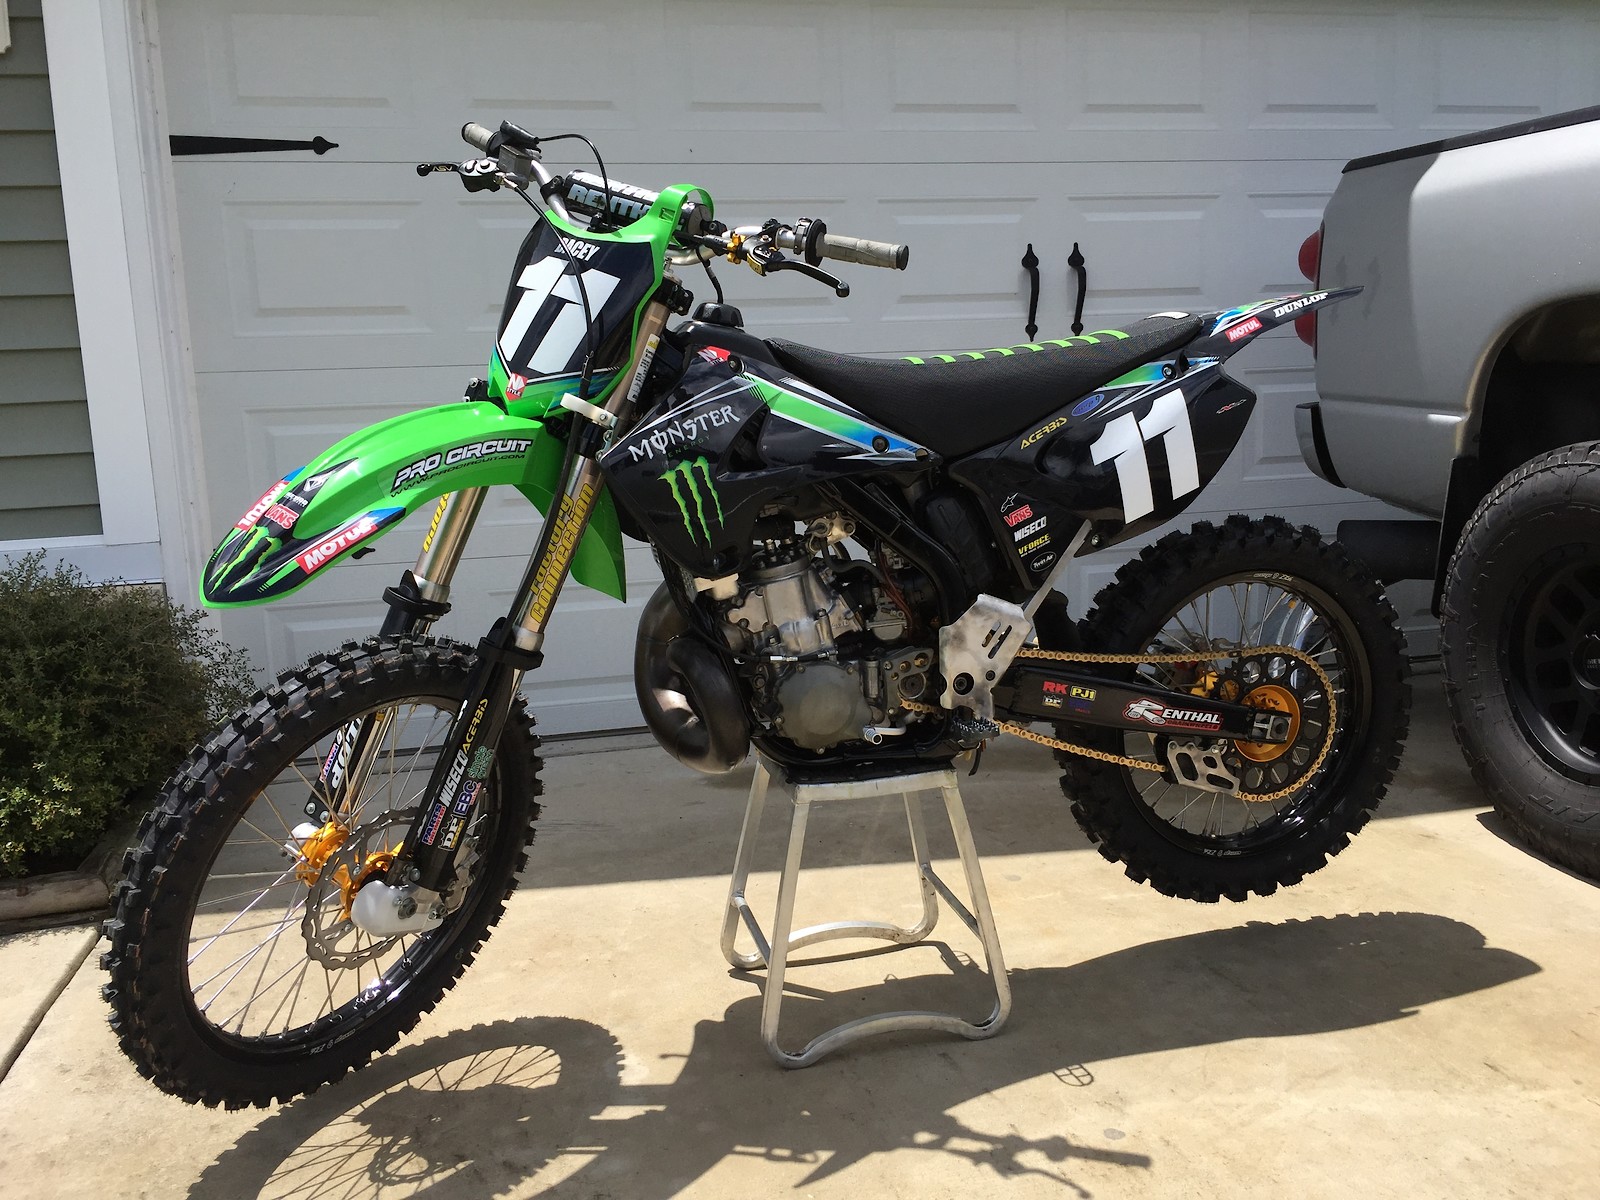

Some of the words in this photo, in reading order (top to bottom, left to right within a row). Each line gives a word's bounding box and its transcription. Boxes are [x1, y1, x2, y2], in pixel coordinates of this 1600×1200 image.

[499, 256, 621, 375] 11
[1273, 293, 1328, 318] DUNLOP
[1229, 320, 1260, 340] MOTUL
[628, 405, 740, 462] MONSTER
[391, 453, 442, 491] PRO
[446, 439, 533, 465] CIRCUIT
[1089, 388, 1200, 525] 11
[264, 503, 299, 529] VANS
[1004, 504, 1033, 527] VANS
[1014, 516, 1047, 542] WISECO
[1042, 681, 1068, 694] RK
[1126, 699, 1221, 725] RENTHAL
[438, 749, 469, 808] WISECO
[463, 698, 488, 754] ACERBIS
[453, 779, 477, 816] EBC
